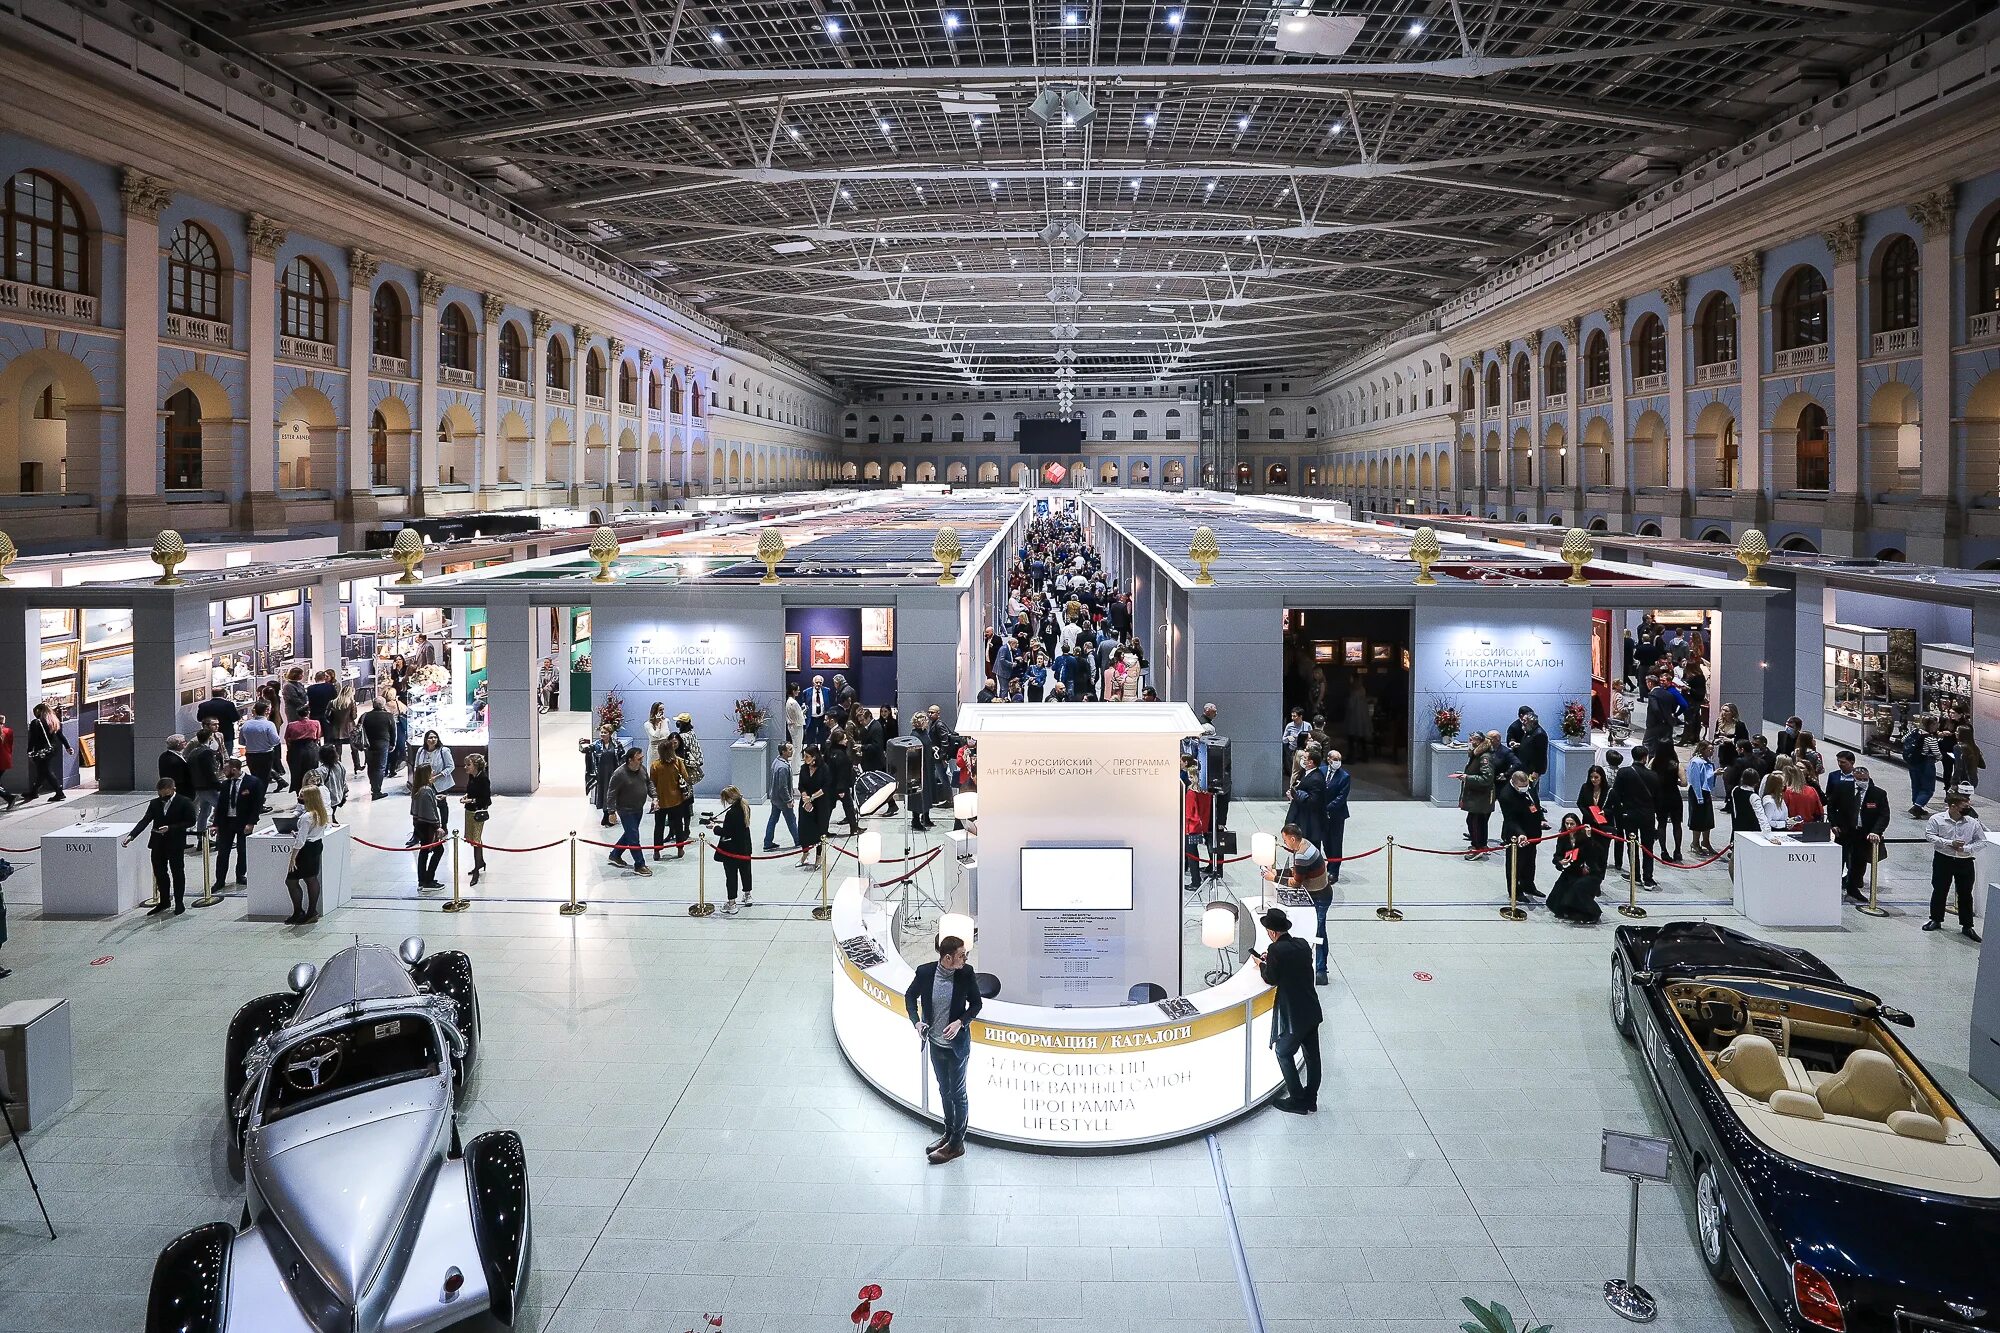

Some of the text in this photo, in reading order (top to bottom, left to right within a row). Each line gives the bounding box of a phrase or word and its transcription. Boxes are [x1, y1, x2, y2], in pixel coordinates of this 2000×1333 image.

[627, 644, 717, 655] 47 РОИЙСКИ
[1444, 648, 1457, 657] 47
[627, 656, 746, 665] АНТИКВАРНЫЙ САЛОН
[1444, 658, 1564, 668] АНТИКВАРНЫЙ САЛОН
[648, 667, 712, 676] ПРОГРАММА
[1465, 669, 1530, 678] ПРОГРАММА
[648, 677, 700, 687] LIFESTYLE
[1465, 680, 1518, 689] LIFESTYLE
[1011, 757, 1093, 767] 47 РОССИЙСКИЙ
[1112, 758, 1171, 767] ПРОГРАММА
[986, 767, 1093, 776] АНТИКВАРНЫЙ САЛОН
[1112, 768, 1160, 776] LIFESTYLE
[66, 843, 92, 853] ВХОД
[271, 844, 291, 853] ВХО
[1788, 853, 1816, 863] ВХОД
[862, 977, 892, 1006] КАССА
[984, 1026, 1098, 1051] ИНФОРМАЦИЯ
[1111, 1024, 1192, 1048] КАТАЛОГИ
[1023, 1097, 1136, 1114] ПРОГРАММА
[1023, 1115, 1114, 1132] LIFESTYLE
